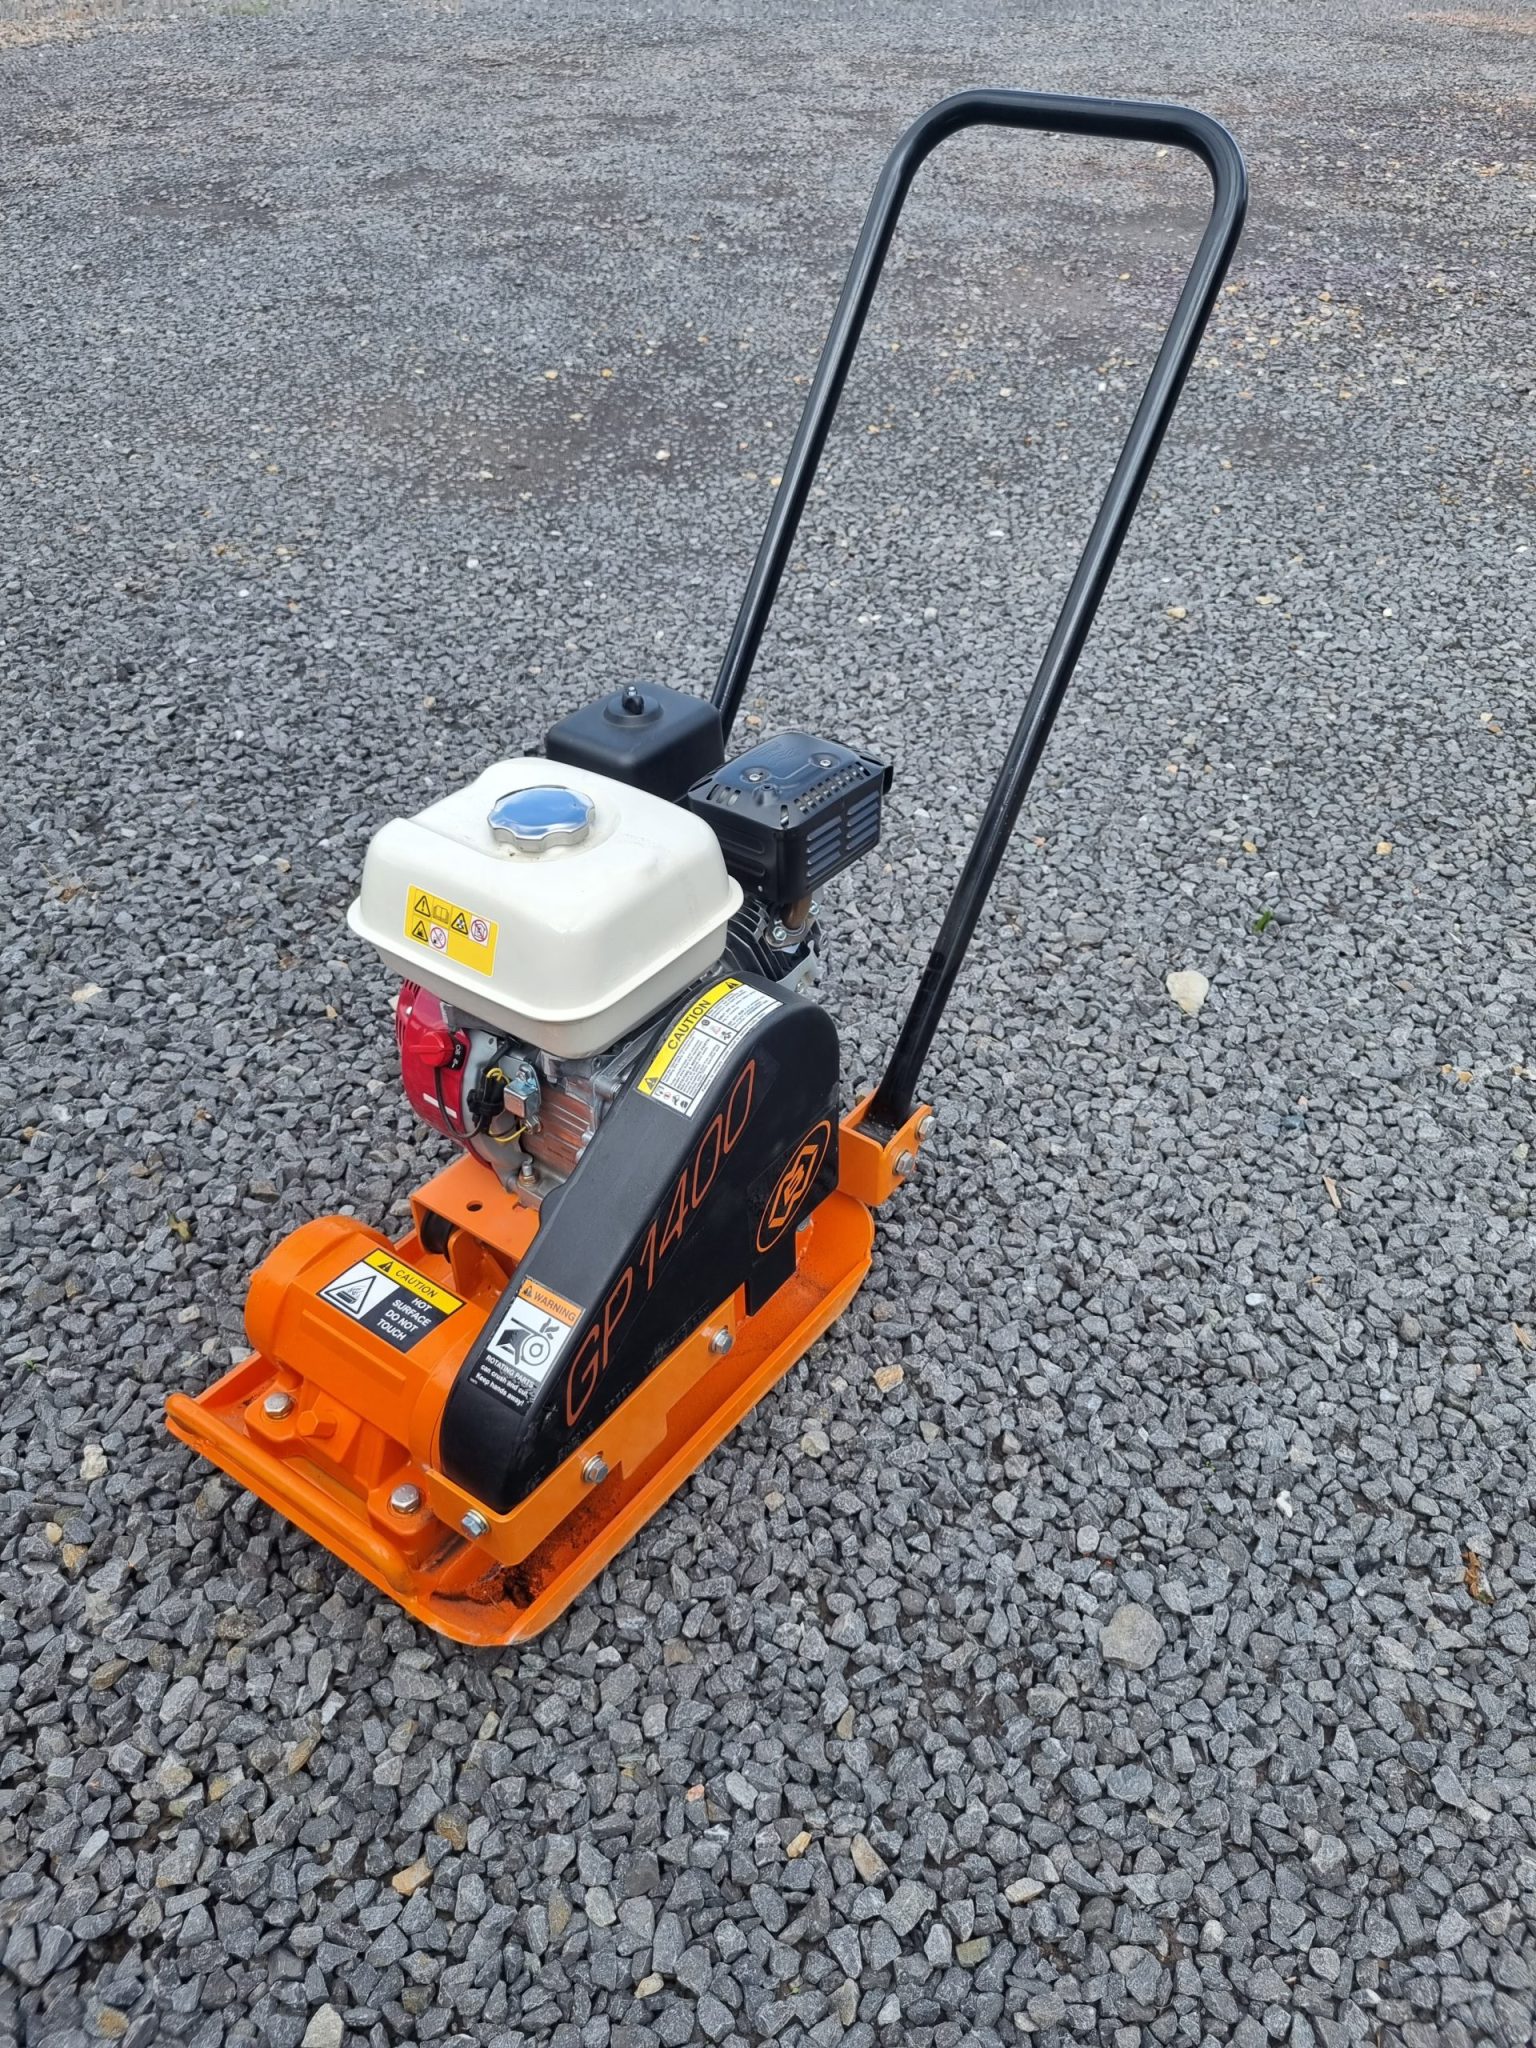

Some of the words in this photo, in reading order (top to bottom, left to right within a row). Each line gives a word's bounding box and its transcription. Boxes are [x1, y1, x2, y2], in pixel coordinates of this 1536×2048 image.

[667, 999, 711, 1050] CAUTION
[565, 1059, 756, 1427] GP1400
[395, 1269, 438, 1298] CAUTION
[392, 1299, 432, 1327] SURFACE
[411, 1298, 432, 1311] HOT
[534, 1292, 577, 1321] WARNING
[377, 1318, 407, 1341] TOUCH
[385, 1309, 400, 1321] DO
[398, 1318, 418, 1332] NOT
[480, 1364, 491, 1374] can
[485, 1354, 515, 1376] ROTATING
[514, 1372, 535, 1389] PARTS
[490, 1381, 507, 1396] hands
